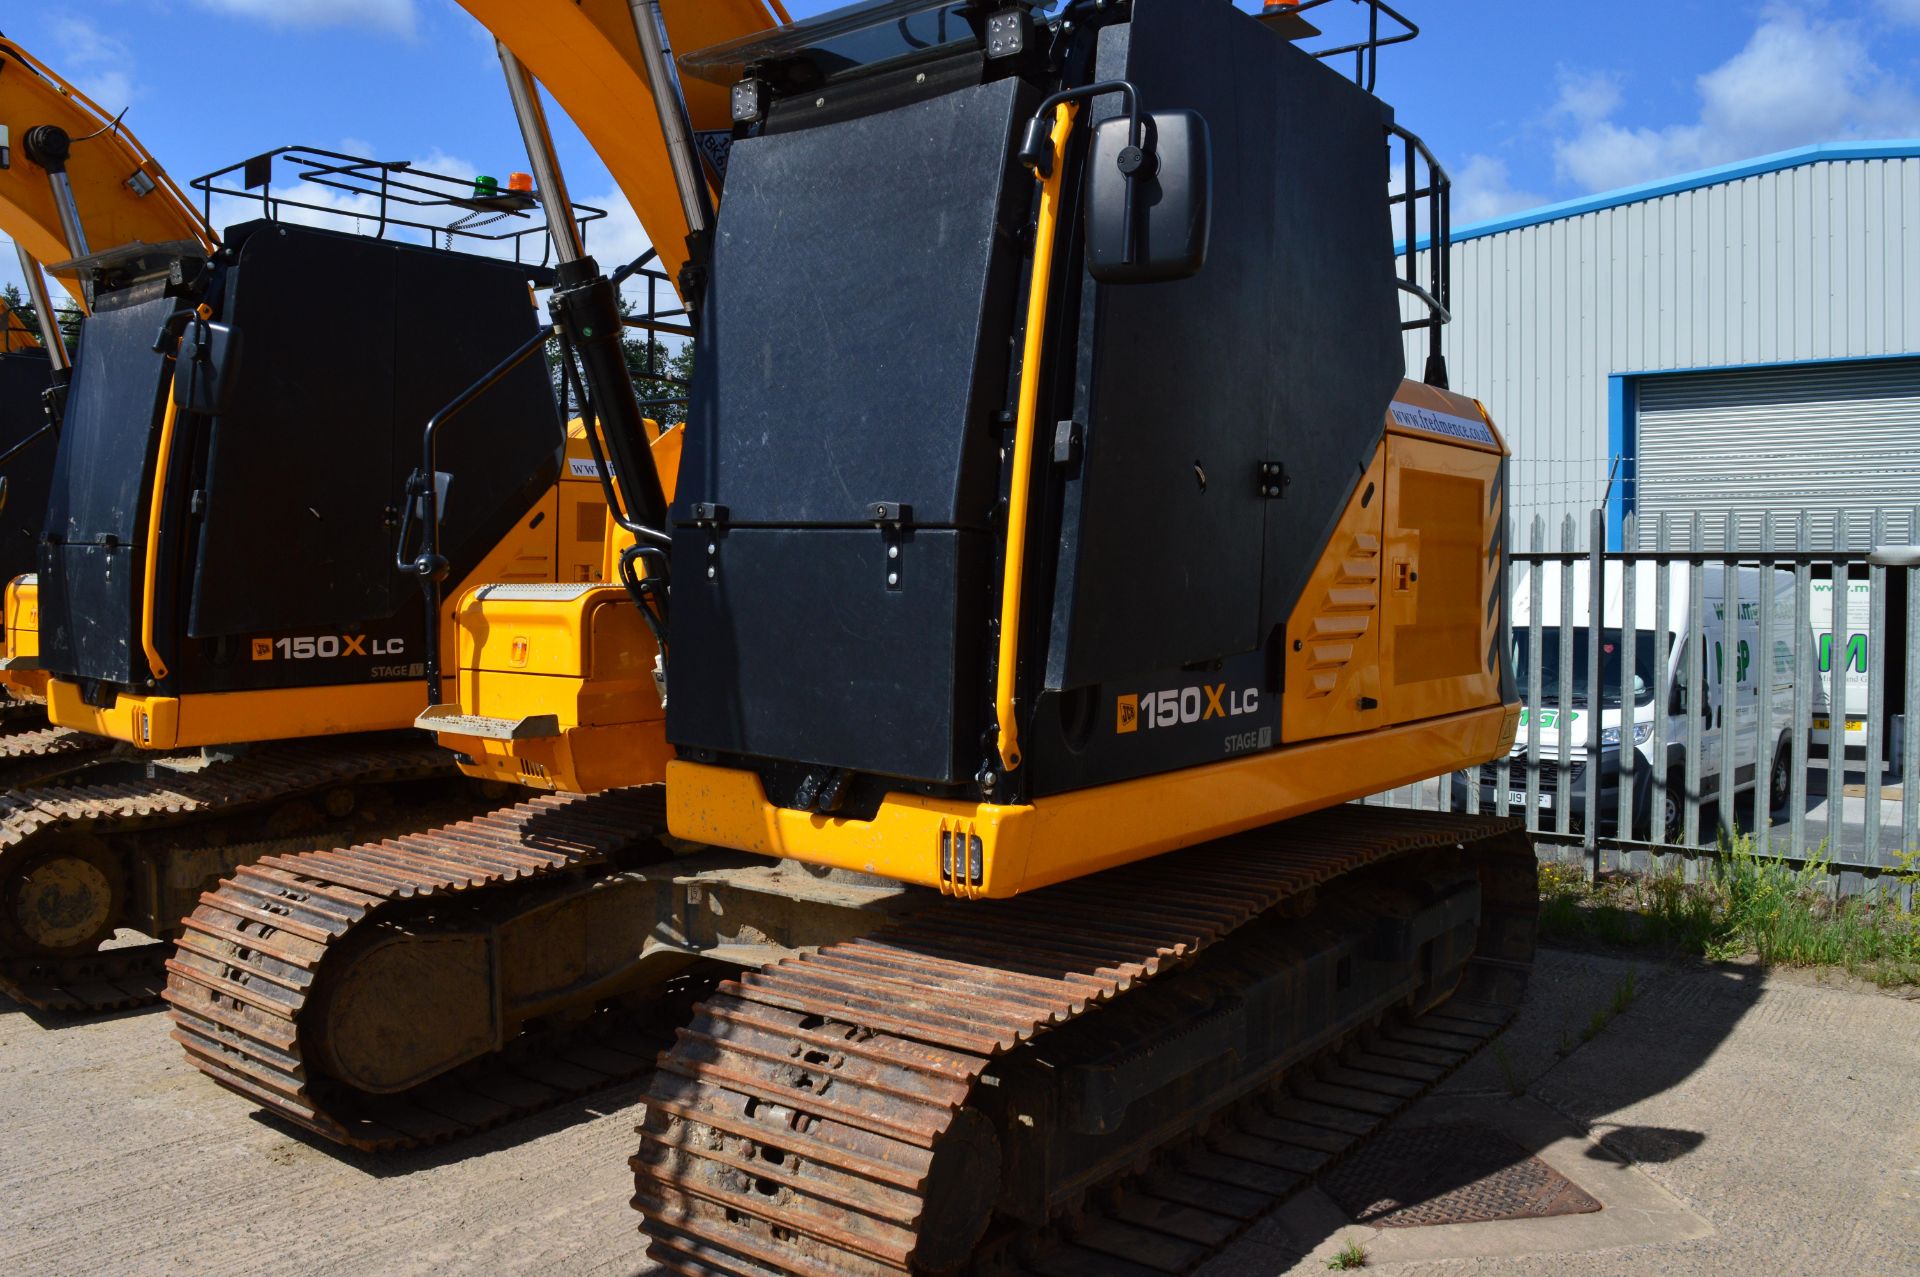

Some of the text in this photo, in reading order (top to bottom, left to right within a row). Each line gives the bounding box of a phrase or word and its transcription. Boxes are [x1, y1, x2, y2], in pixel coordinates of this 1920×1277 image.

[1392, 409, 1494, 443] www.fredmence.co.uk
[372, 638, 404, 655] LC
[371, 665, 407, 677] STAGE
[1230, 687, 1258, 716] LC
[1224, 732, 1257, 753] STAGE
